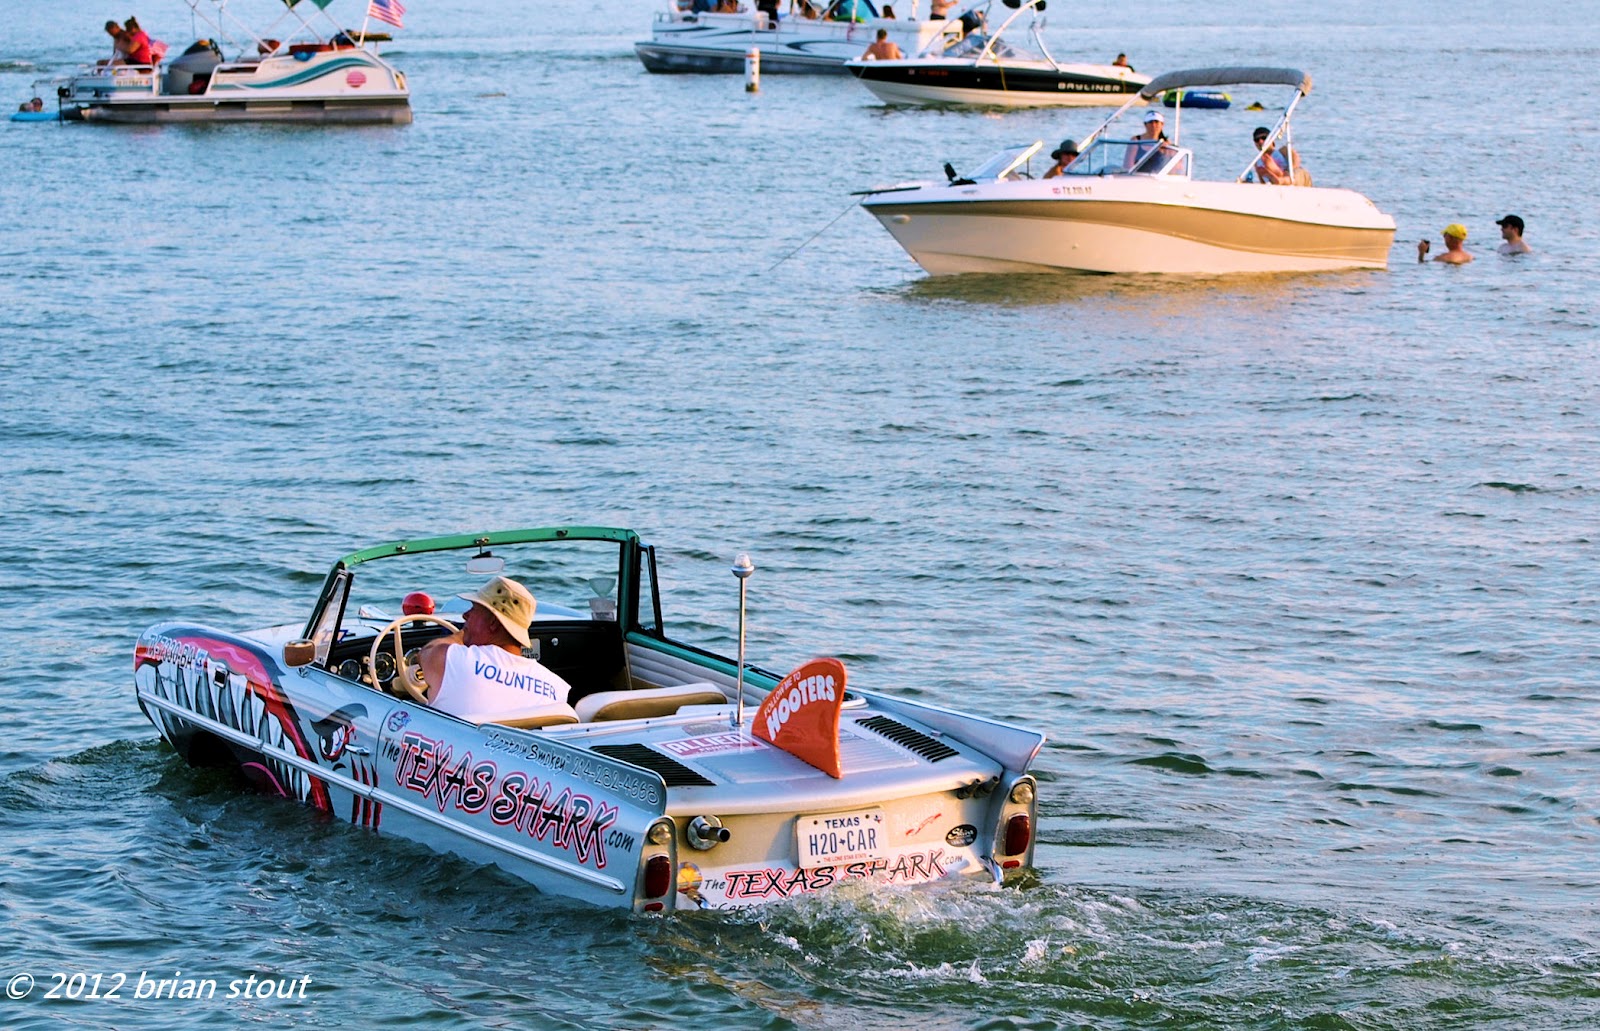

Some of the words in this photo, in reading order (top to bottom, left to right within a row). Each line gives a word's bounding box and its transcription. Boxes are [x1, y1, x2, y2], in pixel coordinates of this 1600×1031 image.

[1057, 81, 1120, 92] BAYLINER
[474, 660, 557, 701] VOLUNTEER
[793, 671, 801, 682] TO
[766, 674, 836, 742] HOOTERS
[381, 736, 400, 763] The
[395, 731, 498, 815] TEXAS
[825, 817, 860, 829] TEXAS
[704, 879, 725, 890] The
[725, 866, 838, 898] TEXAS
